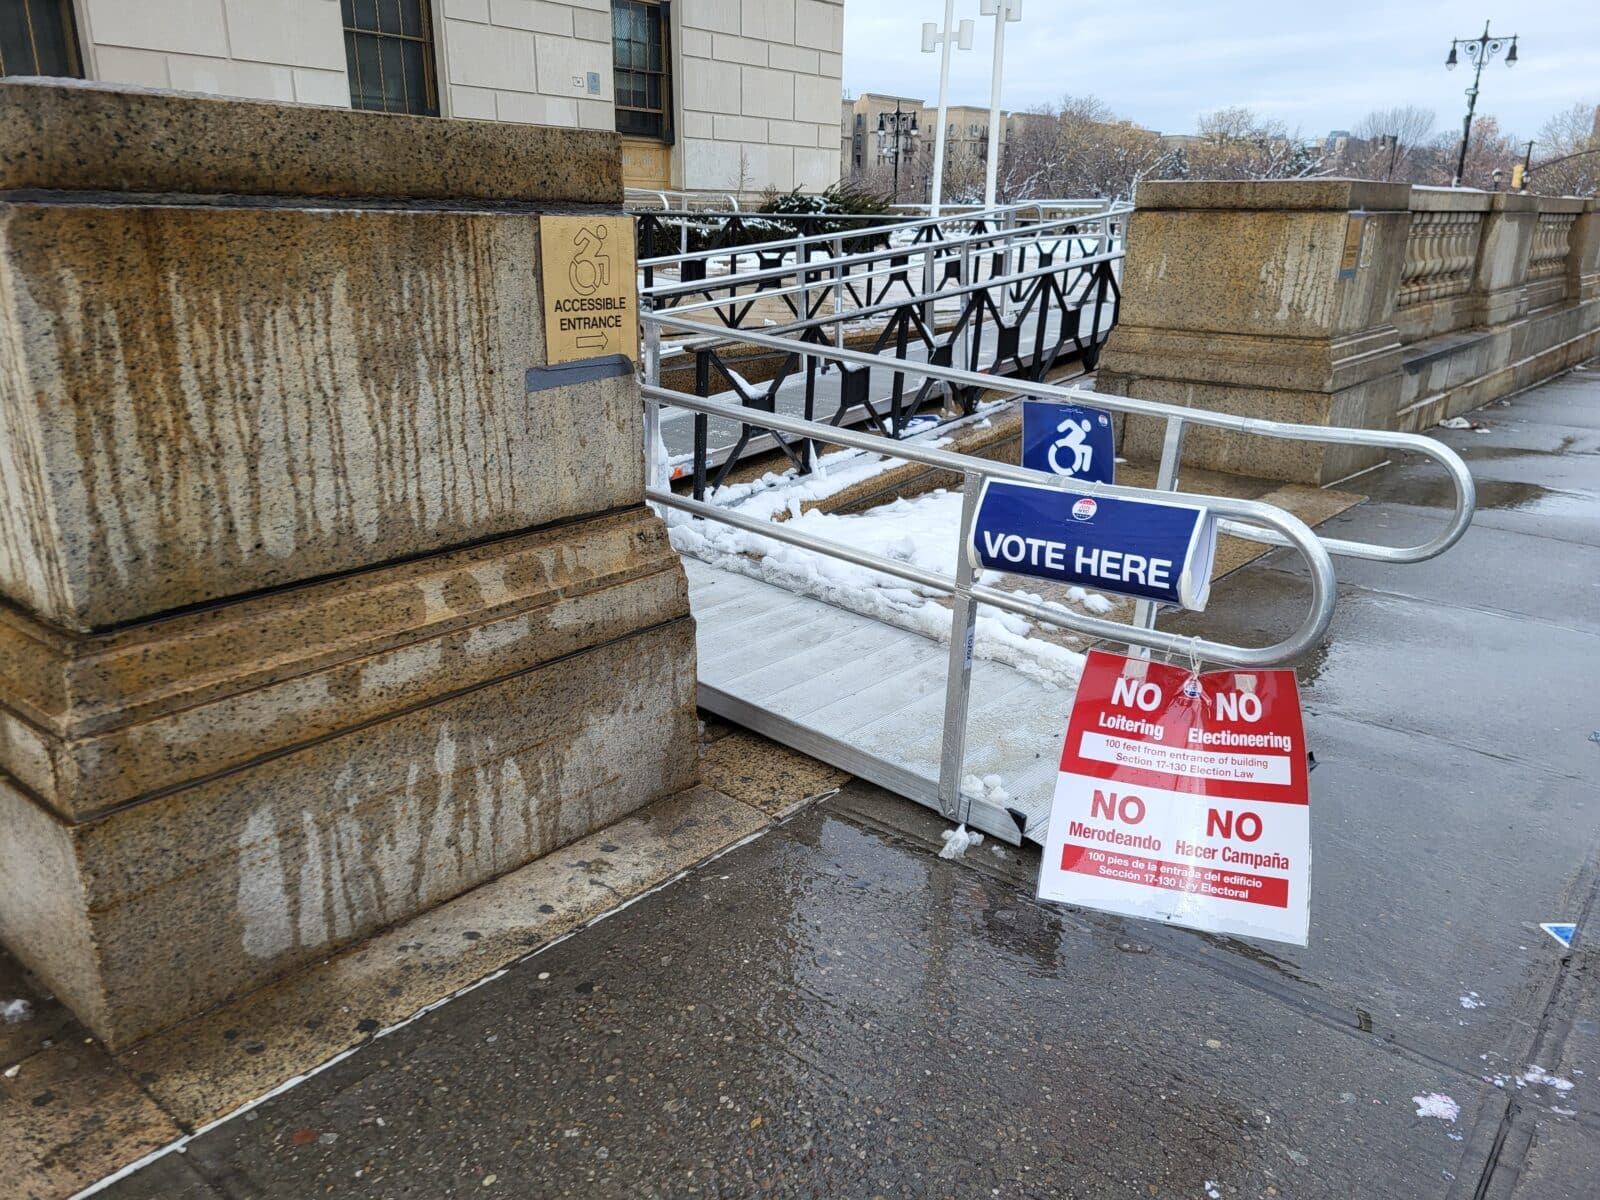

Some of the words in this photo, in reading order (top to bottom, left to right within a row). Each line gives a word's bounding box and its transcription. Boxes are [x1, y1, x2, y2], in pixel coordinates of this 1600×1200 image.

[554, 297, 626, 312] ACCESSIBLE
[560, 315, 622, 331] ENTRANCE
[983, 530, 1066, 571] VOTE
[1075, 546, 1172, 589] HERE
[1111, 677, 1162, 711] NO
[1216, 692, 1262, 722] NO
[1098, 712, 1164, 741] Loitering
[1188, 728, 1292, 752] Electioneering
[1105, 739, 1120, 749] 100
[1122, 741, 1141, 752] feet
[1143, 745, 1167, 757] from
[1169, 751, 1216, 764] entrance
[1218, 754, 1229, 765] of
[1231, 755, 1268, 769] building
[1115, 752, 1152, 766] Section
[1155, 760, 1187, 772] 17-130
[1190, 764, 1232, 777] Election
[1234, 769, 1254, 779] Law
[1091, 789, 1146, 824] NO
[1069, 821, 1162, 851] Merodeando
[1206, 808, 1263, 842] NO
[1088, 851, 1105, 863] 100
[1107, 855, 1129, 867] pies
[1131, 858, 1145, 870] de
[1147, 861, 1157, 872] la
[1160, 865, 1201, 879] entrada
[1204, 870, 1221, 882] del
[1223, 873, 1263, 888] edificio
[1175, 839, 1218, 860] Hacer
[1221, 846, 1289, 870] Campaña
[1098, 865, 1140, 881] Sección
[1143, 873, 1176, 887] 17-130
[1201, 883, 1249, 899] Electoral
